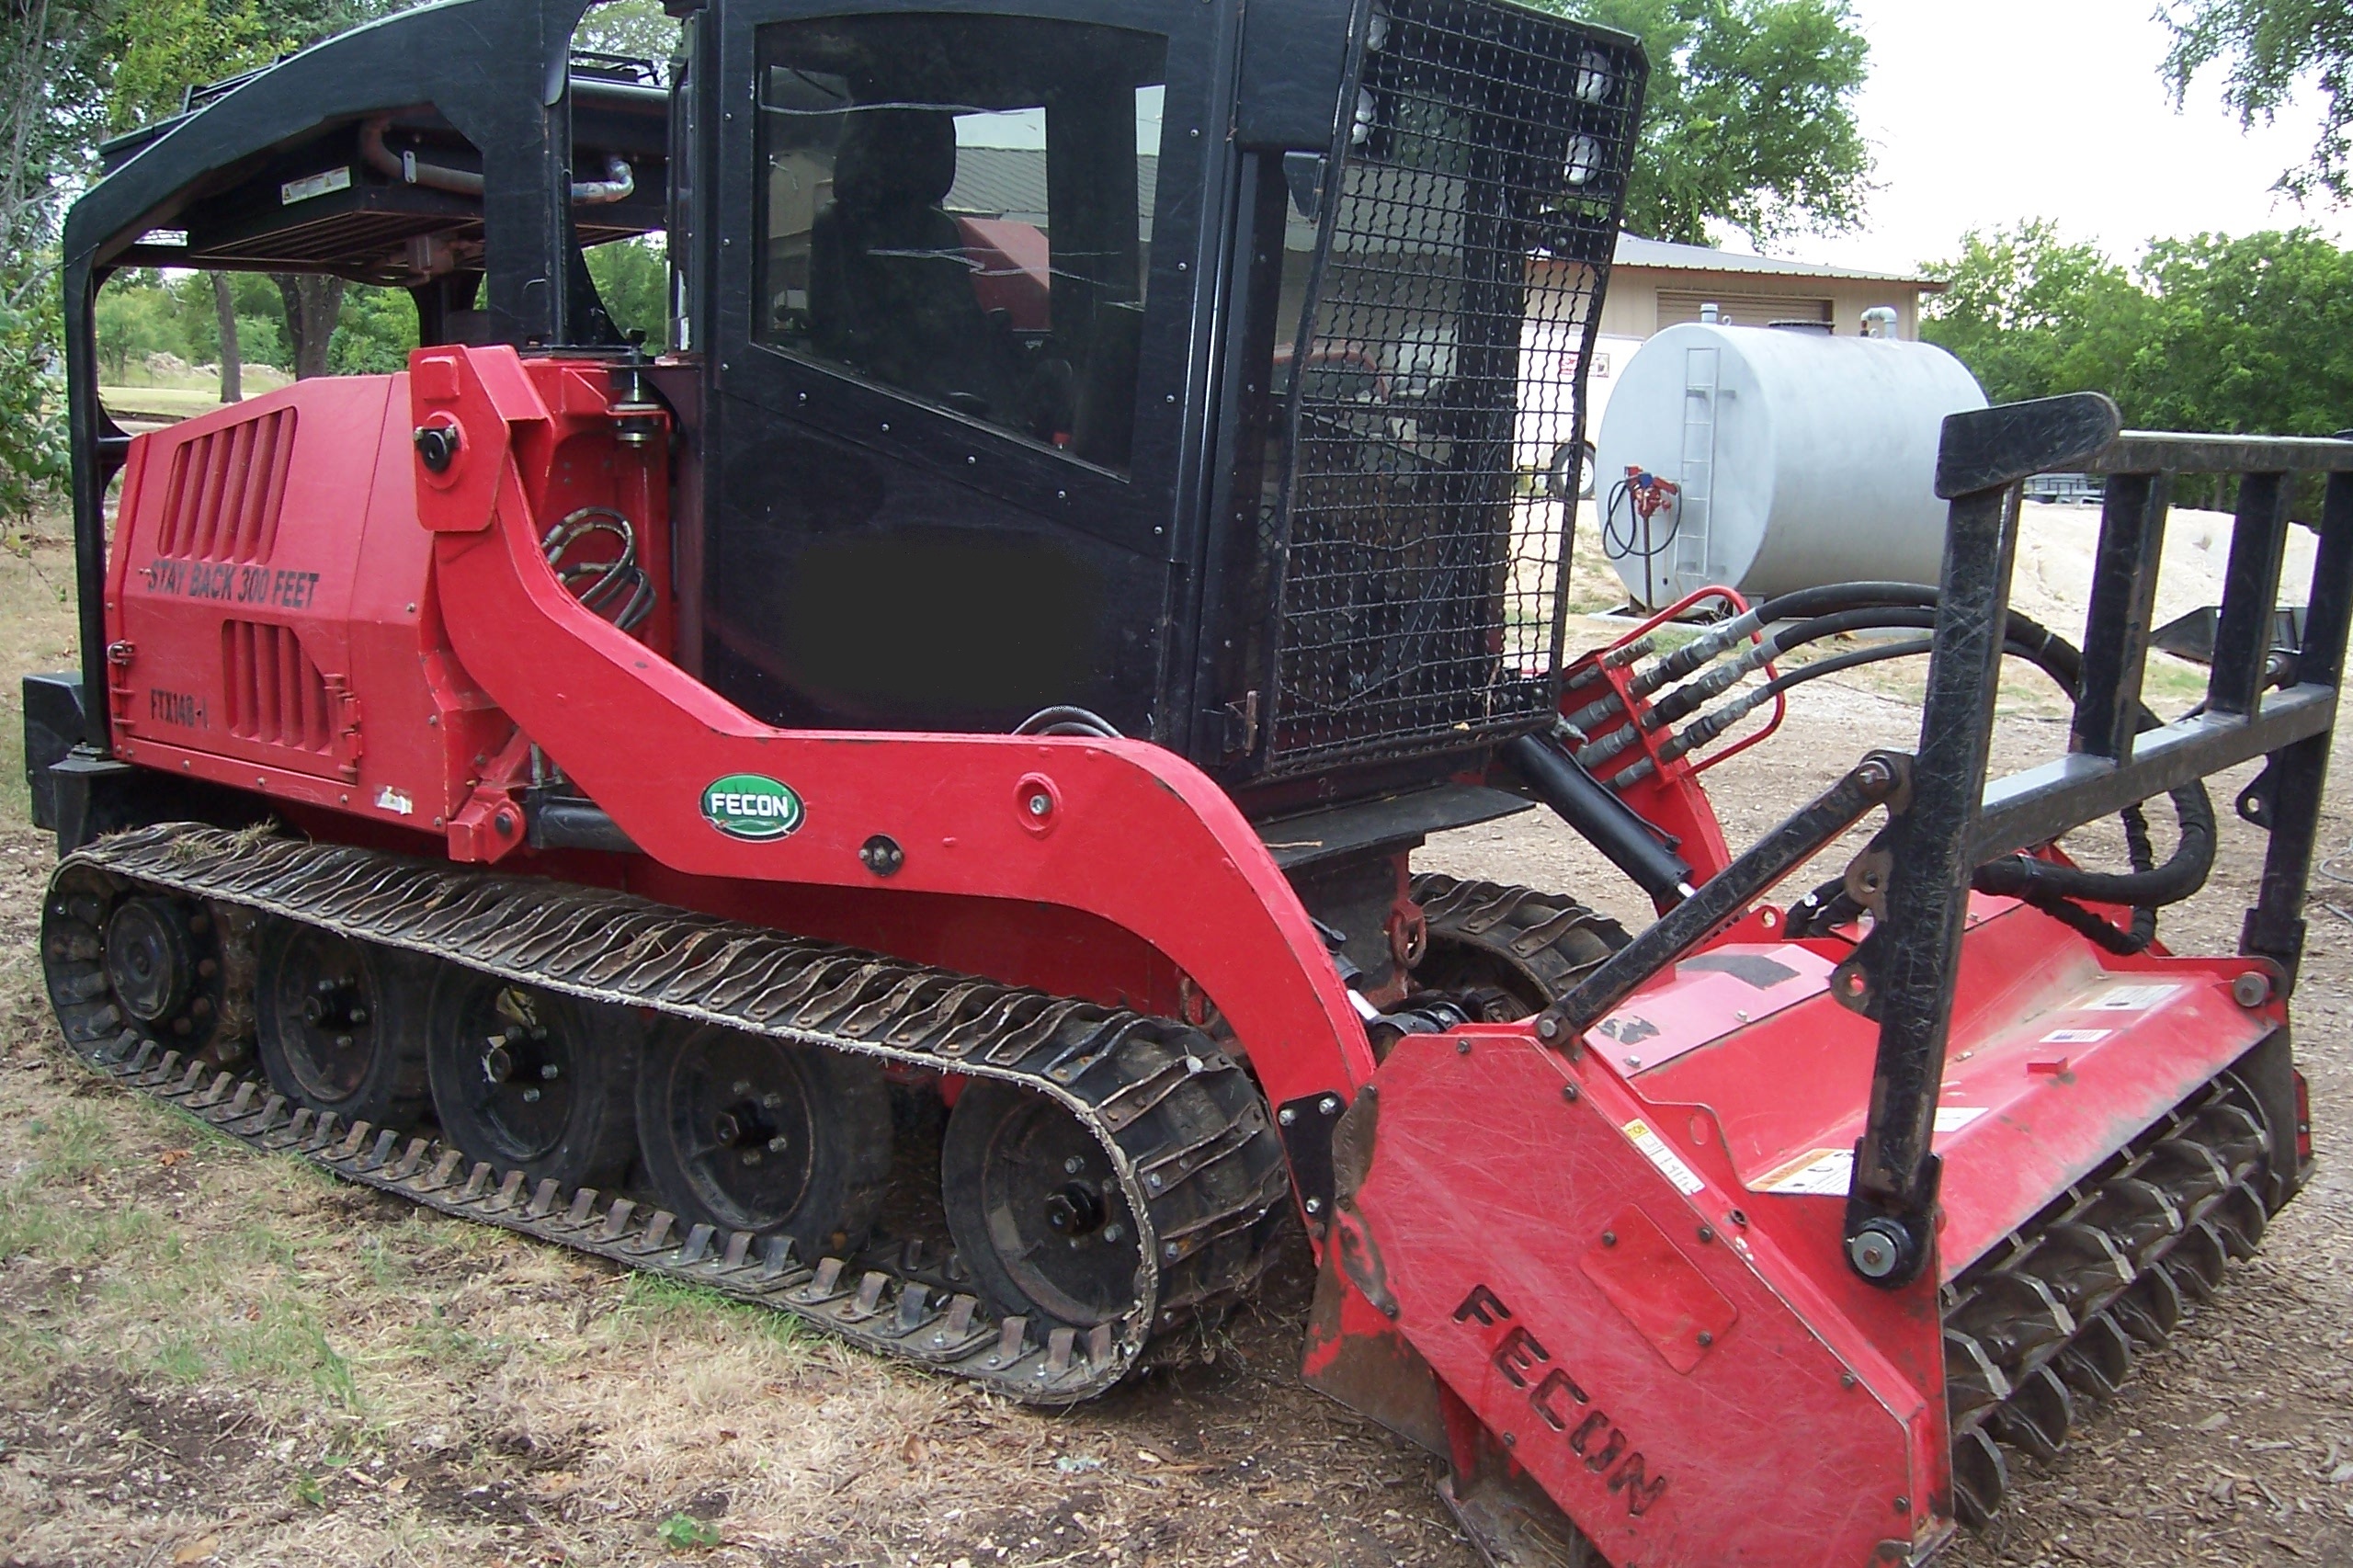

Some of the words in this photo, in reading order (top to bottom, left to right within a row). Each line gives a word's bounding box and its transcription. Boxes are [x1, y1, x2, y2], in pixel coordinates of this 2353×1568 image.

[148, 559, 188, 596] STAY
[188, 562, 236, 601] BACK
[237, 565, 270, 603] 300
[271, 570, 320, 608] FEET
[710, 792, 790, 818] FECON
[1452, 1284, 1665, 1517] FECON
